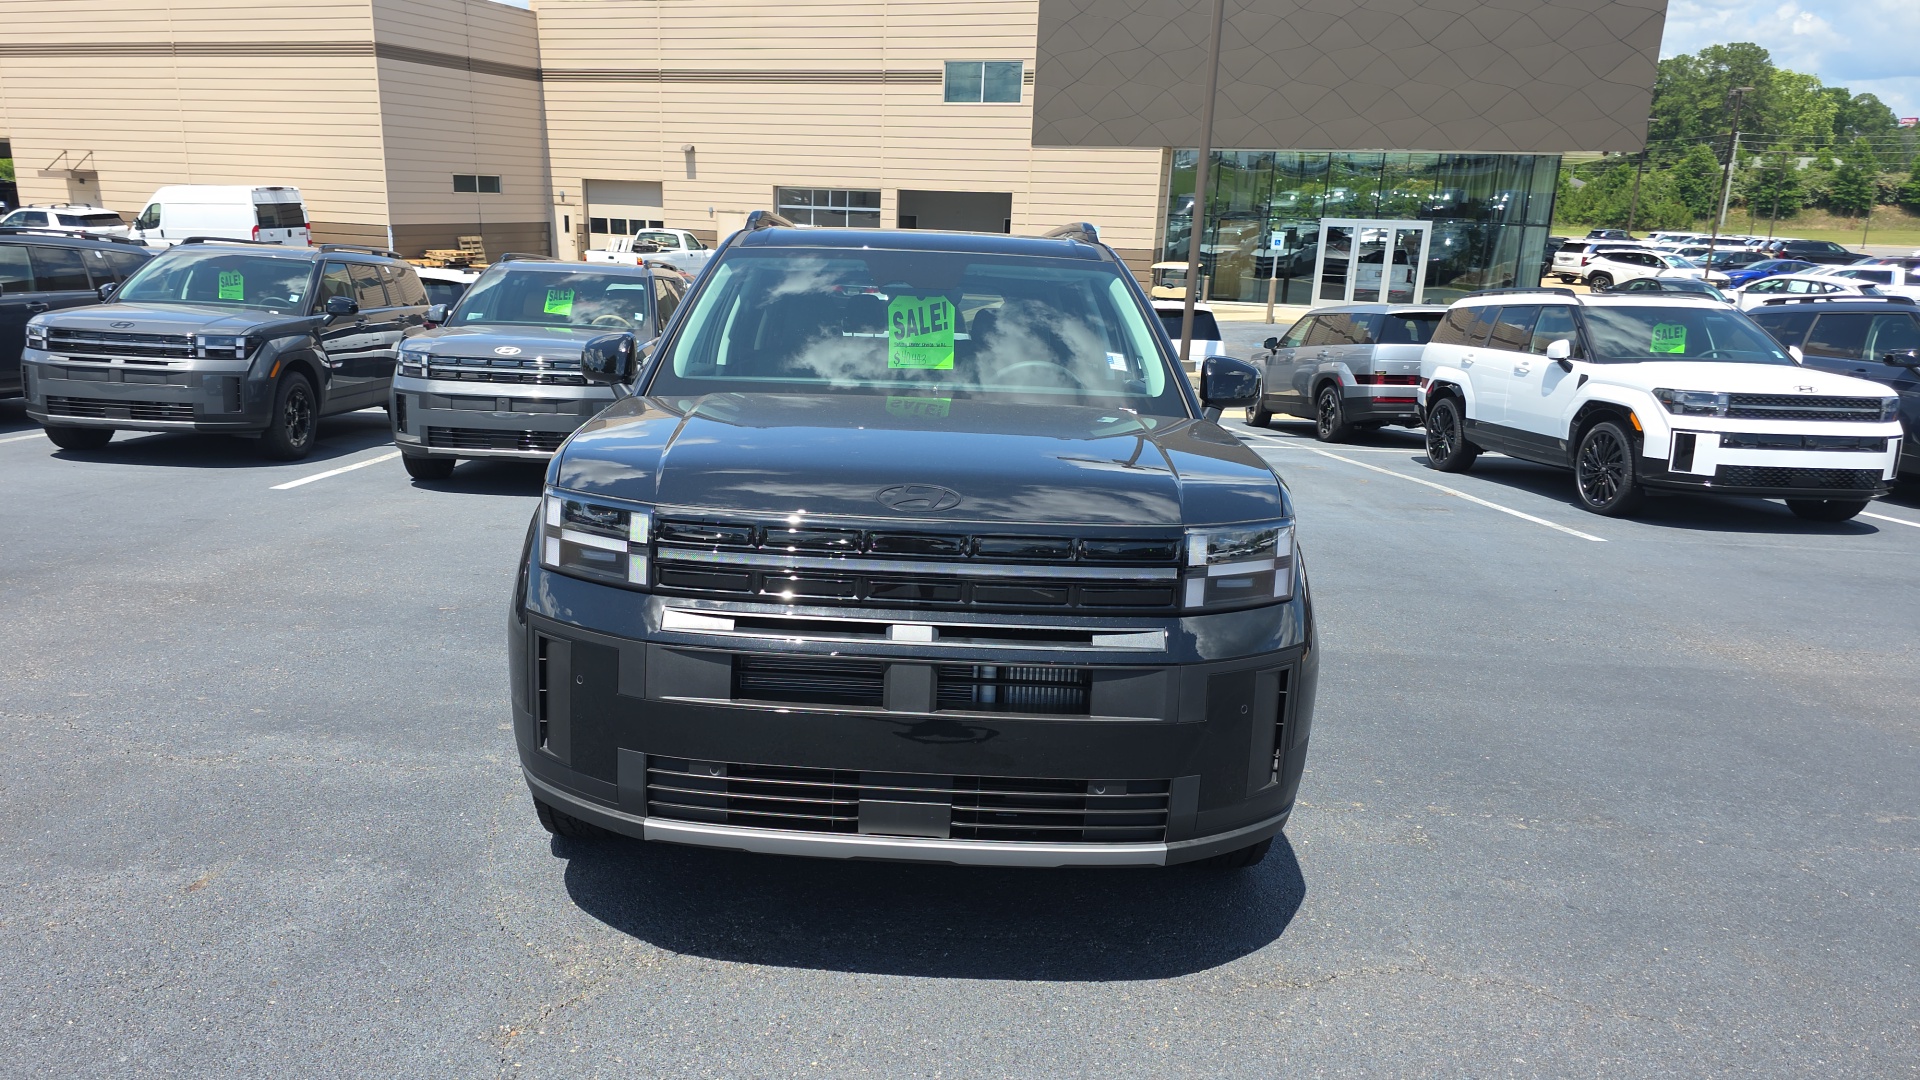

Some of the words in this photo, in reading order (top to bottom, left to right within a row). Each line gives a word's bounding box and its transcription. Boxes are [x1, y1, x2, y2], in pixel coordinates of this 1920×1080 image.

[220, 274, 241, 288] SALE!
[548, 288, 572, 302] SALE!
[892, 301, 949, 341] SALE!
[1654, 326, 1683, 341] SALE!
